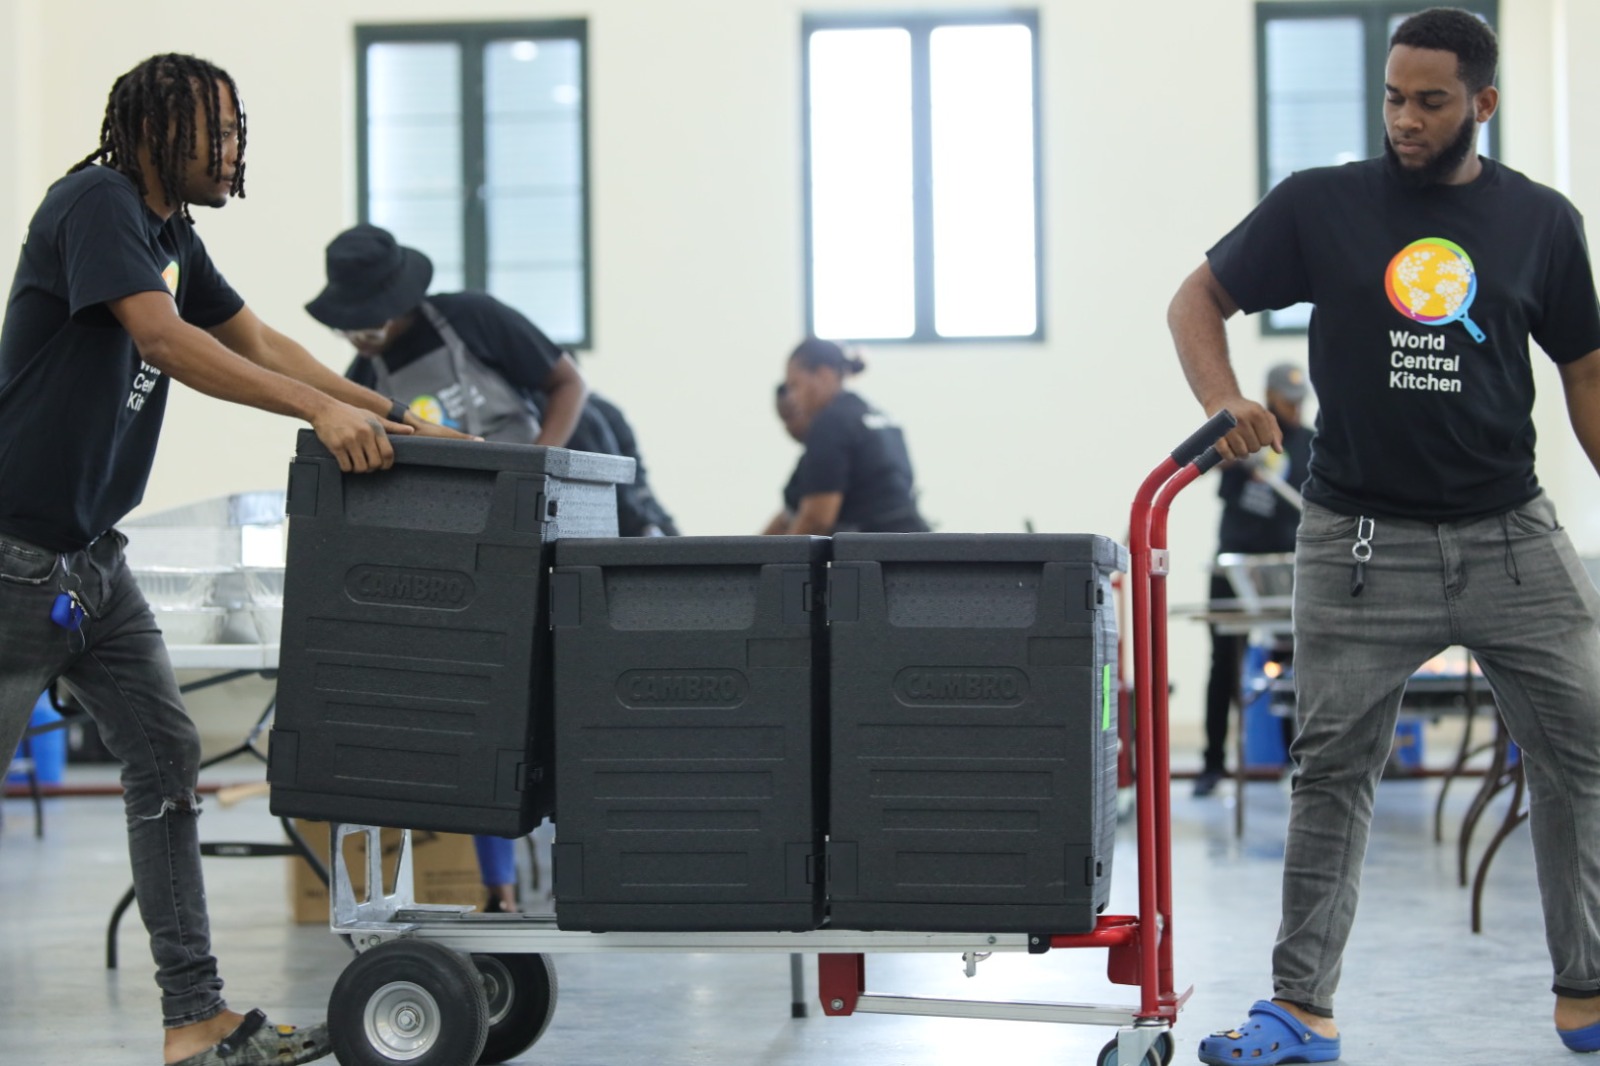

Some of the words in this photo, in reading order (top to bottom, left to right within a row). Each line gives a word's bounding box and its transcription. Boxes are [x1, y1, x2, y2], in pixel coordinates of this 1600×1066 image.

[1389, 330, 1445, 350] World
[1391, 350, 1460, 372] Central
[1389, 370, 1462, 392] Kitchen
[356, 571, 466, 604] CAMBRO
[628, 675, 738, 701] CAMBRO
[904, 673, 1019, 700] CAMBRO
